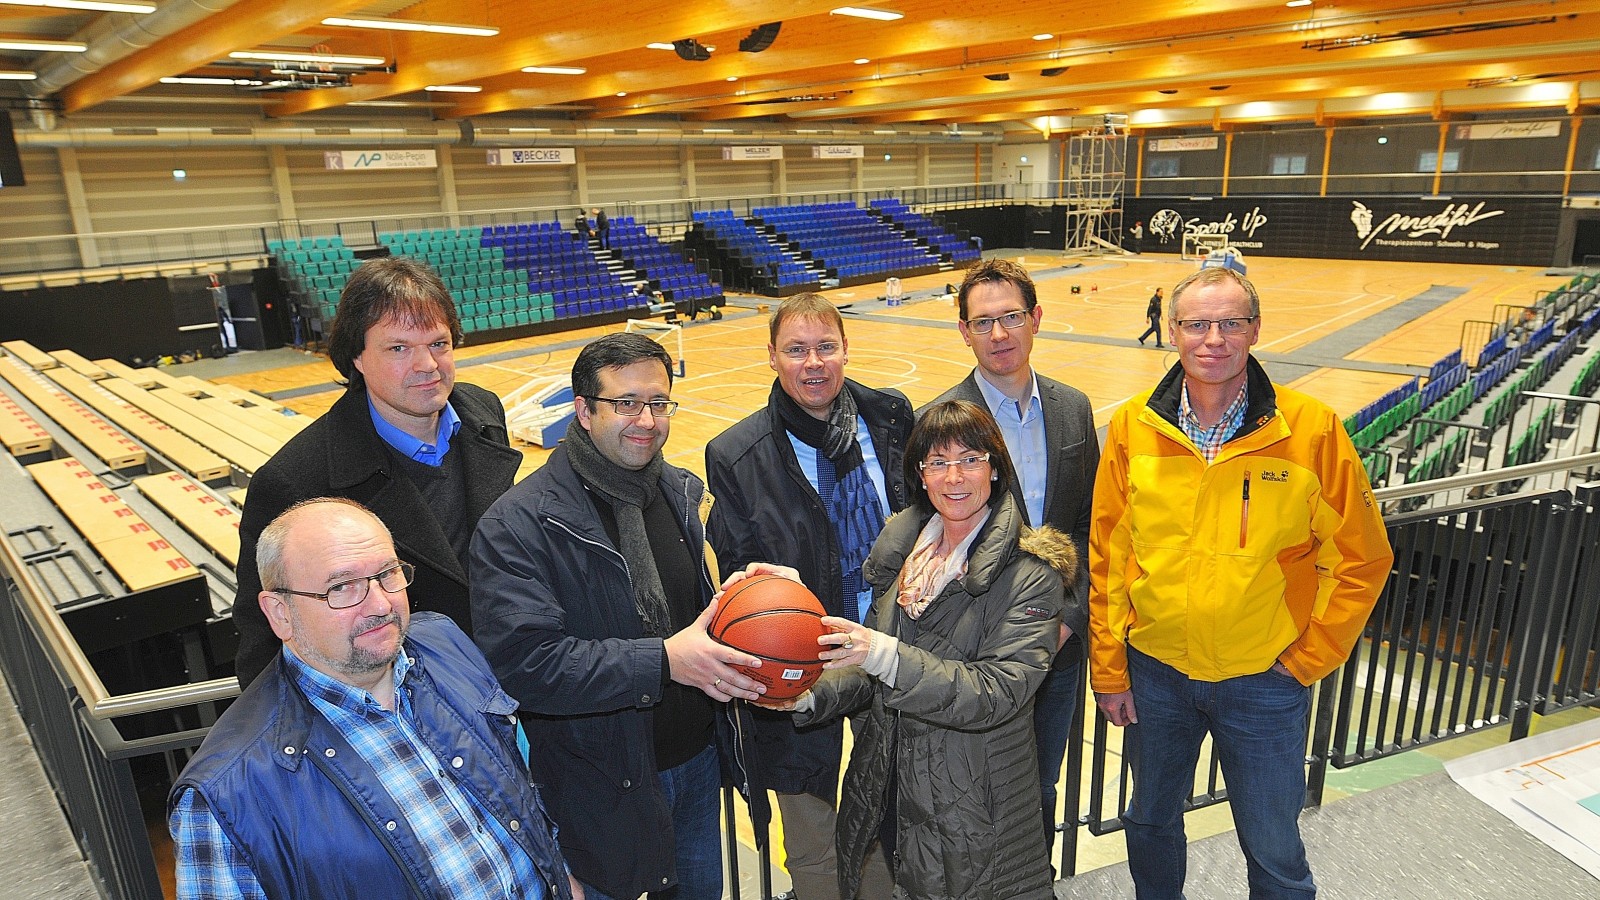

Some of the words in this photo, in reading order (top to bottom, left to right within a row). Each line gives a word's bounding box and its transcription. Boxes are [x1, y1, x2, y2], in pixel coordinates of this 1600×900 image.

[490, 154, 497, 166] J
[524, 150, 561, 160] BECKER
[330, 157, 340, 169] K
[1184, 212, 1237, 244] Sports
[1241, 206, 1268, 238] Up
[1375, 238, 1434, 248] Therapiezentren
[1476, 241, 1500, 250] Hagen
